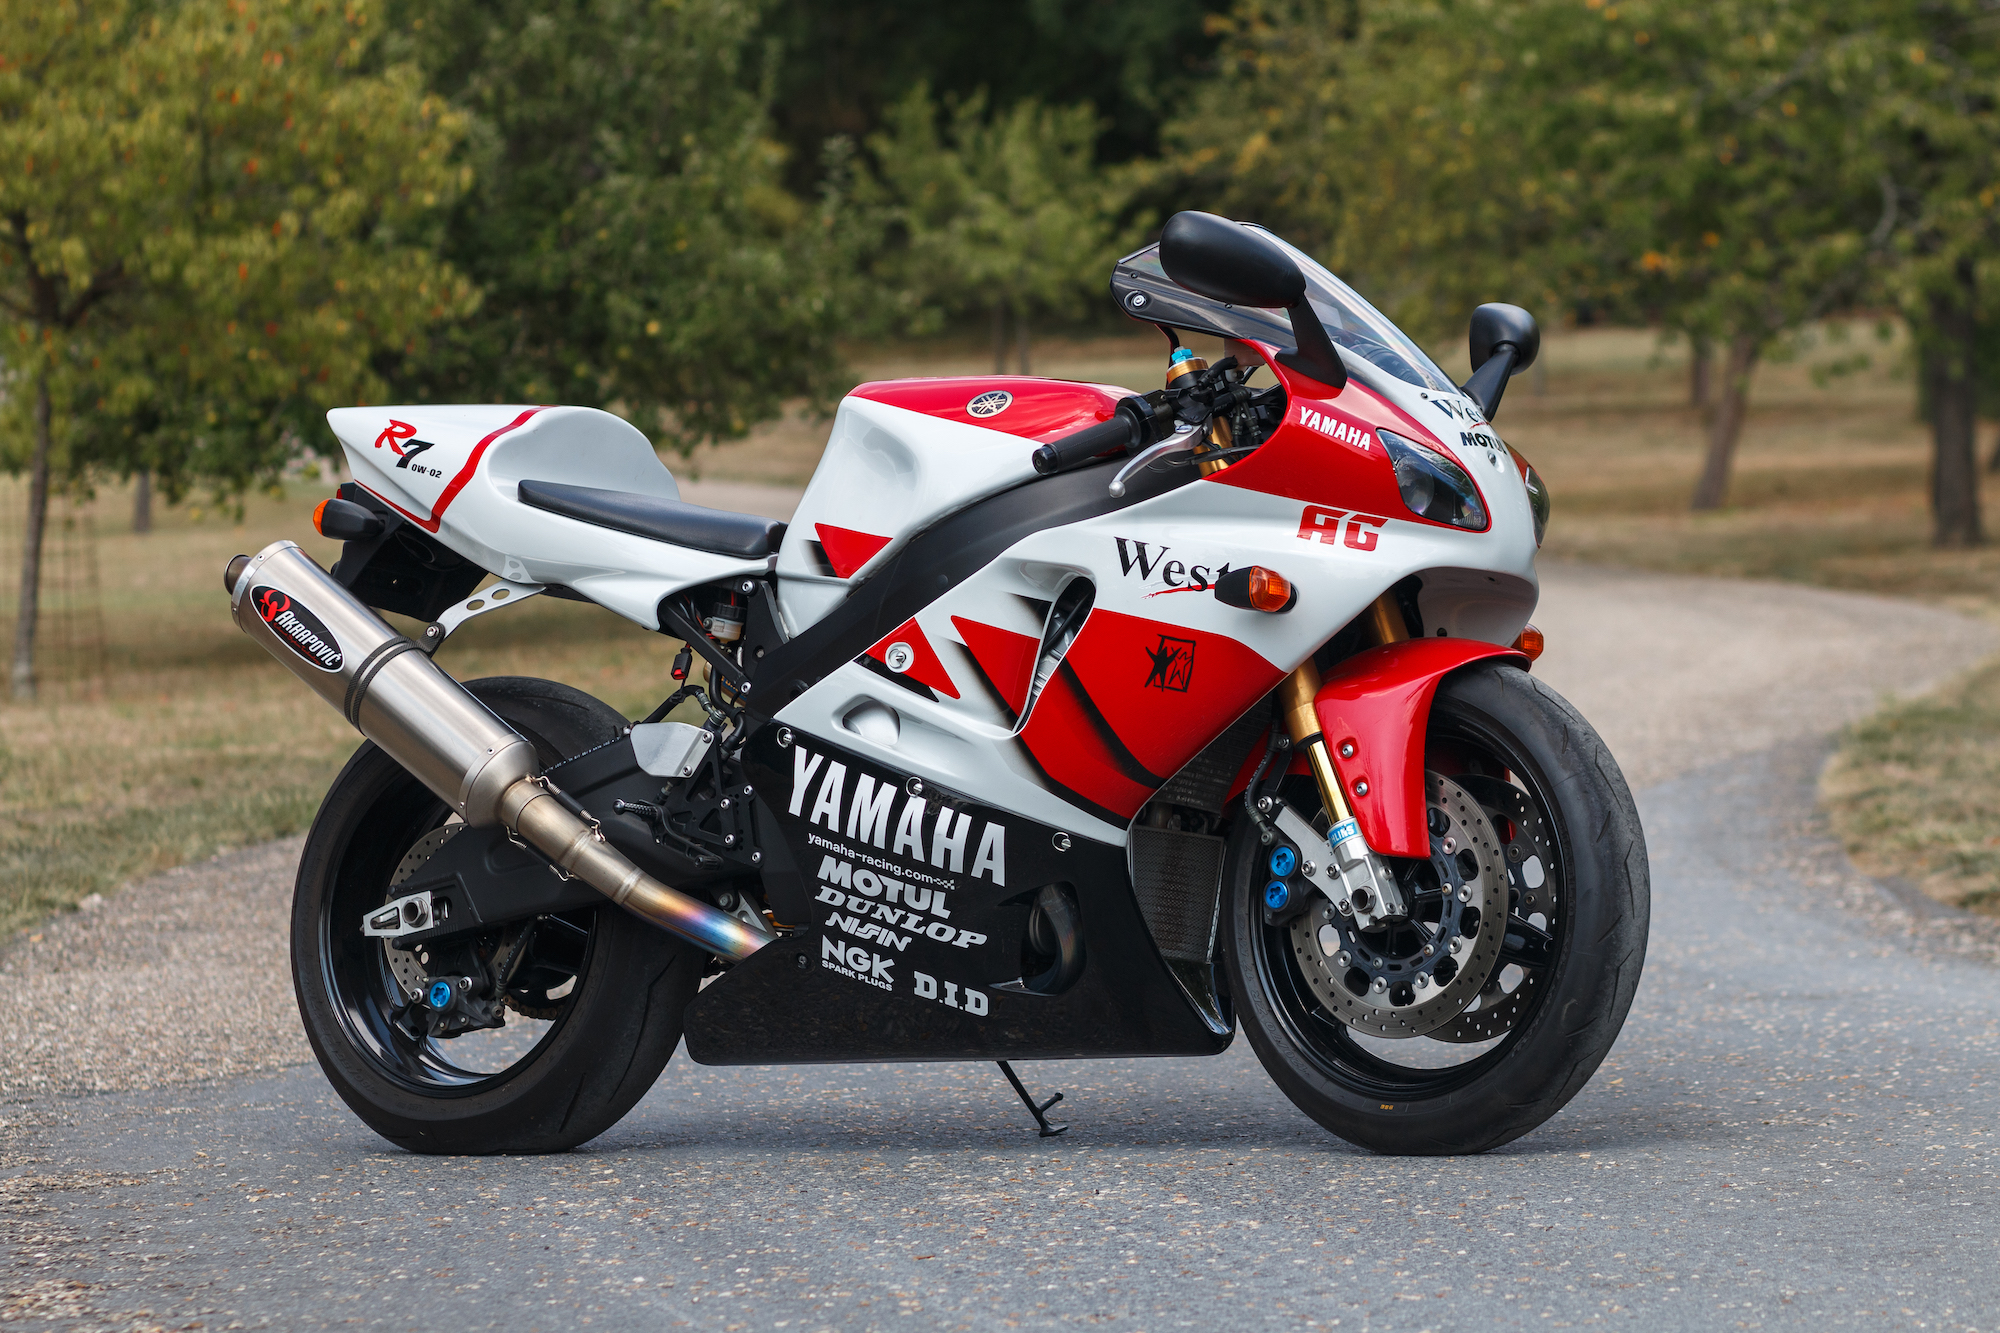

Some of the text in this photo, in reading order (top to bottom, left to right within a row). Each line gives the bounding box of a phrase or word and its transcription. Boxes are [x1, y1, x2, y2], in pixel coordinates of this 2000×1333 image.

[1299, 405, 1371, 451] YAMAHA
[1296, 504, 1389, 552] AG
[788, 744, 1006, 887] YAMAHA
[1329, 823, 1355, 843] HLINS
[807, 832, 935, 885] yamaha-racing.com
[816, 854, 951, 919] MOTUL
[814, 885, 988, 949] DUNLOP
[821, 934, 896, 985] NGK
[821, 959, 893, 992] SPARK PLUGS
[913, 970, 989, 1017] D.I.D
